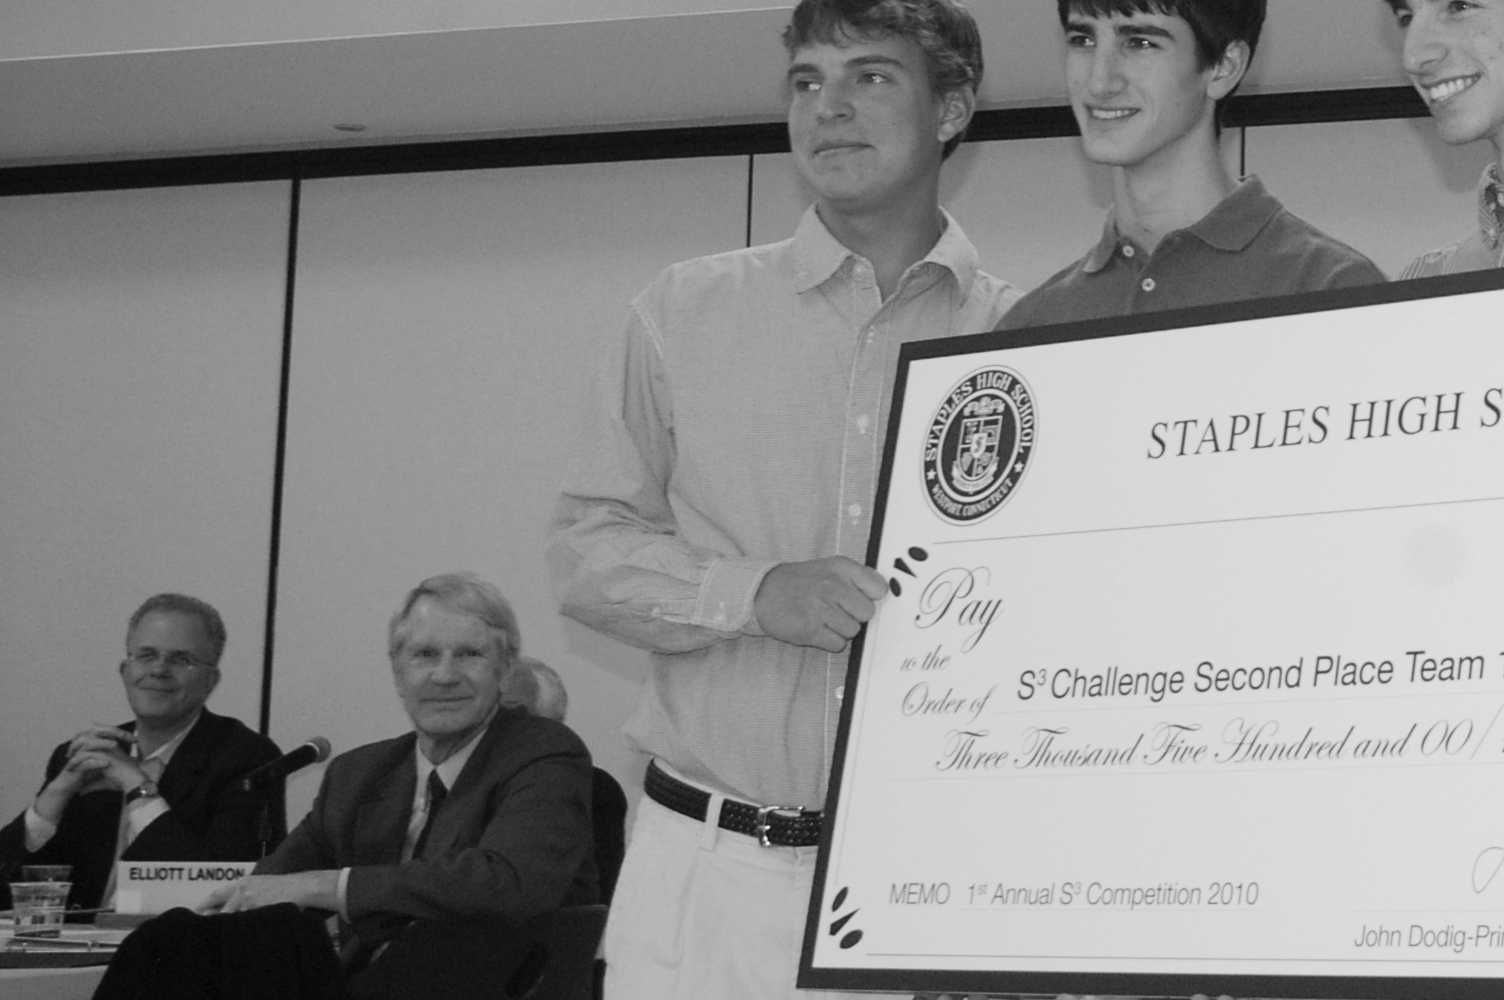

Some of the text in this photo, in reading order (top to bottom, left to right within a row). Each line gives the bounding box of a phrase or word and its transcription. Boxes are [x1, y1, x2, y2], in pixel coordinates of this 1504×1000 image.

[925, 372, 1034, 462] STAPLES HIGH SCHOOL
[1146, 405, 1330, 460] STAPLES
[1345, 391, 1465, 441] HIGH
[914, 565, 1003, 654] Pay
[920, 643, 951, 671] the
[1050, 664, 1185, 703] Challenge
[1194, 656, 1304, 693] Second
[1312, 654, 1395, 688] Place
[1405, 649, 1485, 683] Team
[901, 681, 999, 726] Order of
[935, 728, 1008, 772] Three
[1013, 725, 1145, 770] Thousand
[1143, 721, 1208, 767] Five
[1214, 716, 1356, 765] Hundred
[1352, 722, 1418, 759] and
[129, 867, 245, 881] ELLIOTT LANDON
[889, 881, 951, 906] MEMO
[966, 882, 989, 906] 1st
[991, 881, 1056, 906] Annual
[1086, 881, 1202, 911] Competition
[1207, 881, 1261, 906] 2010
[1353, 923, 1402, 949] John
